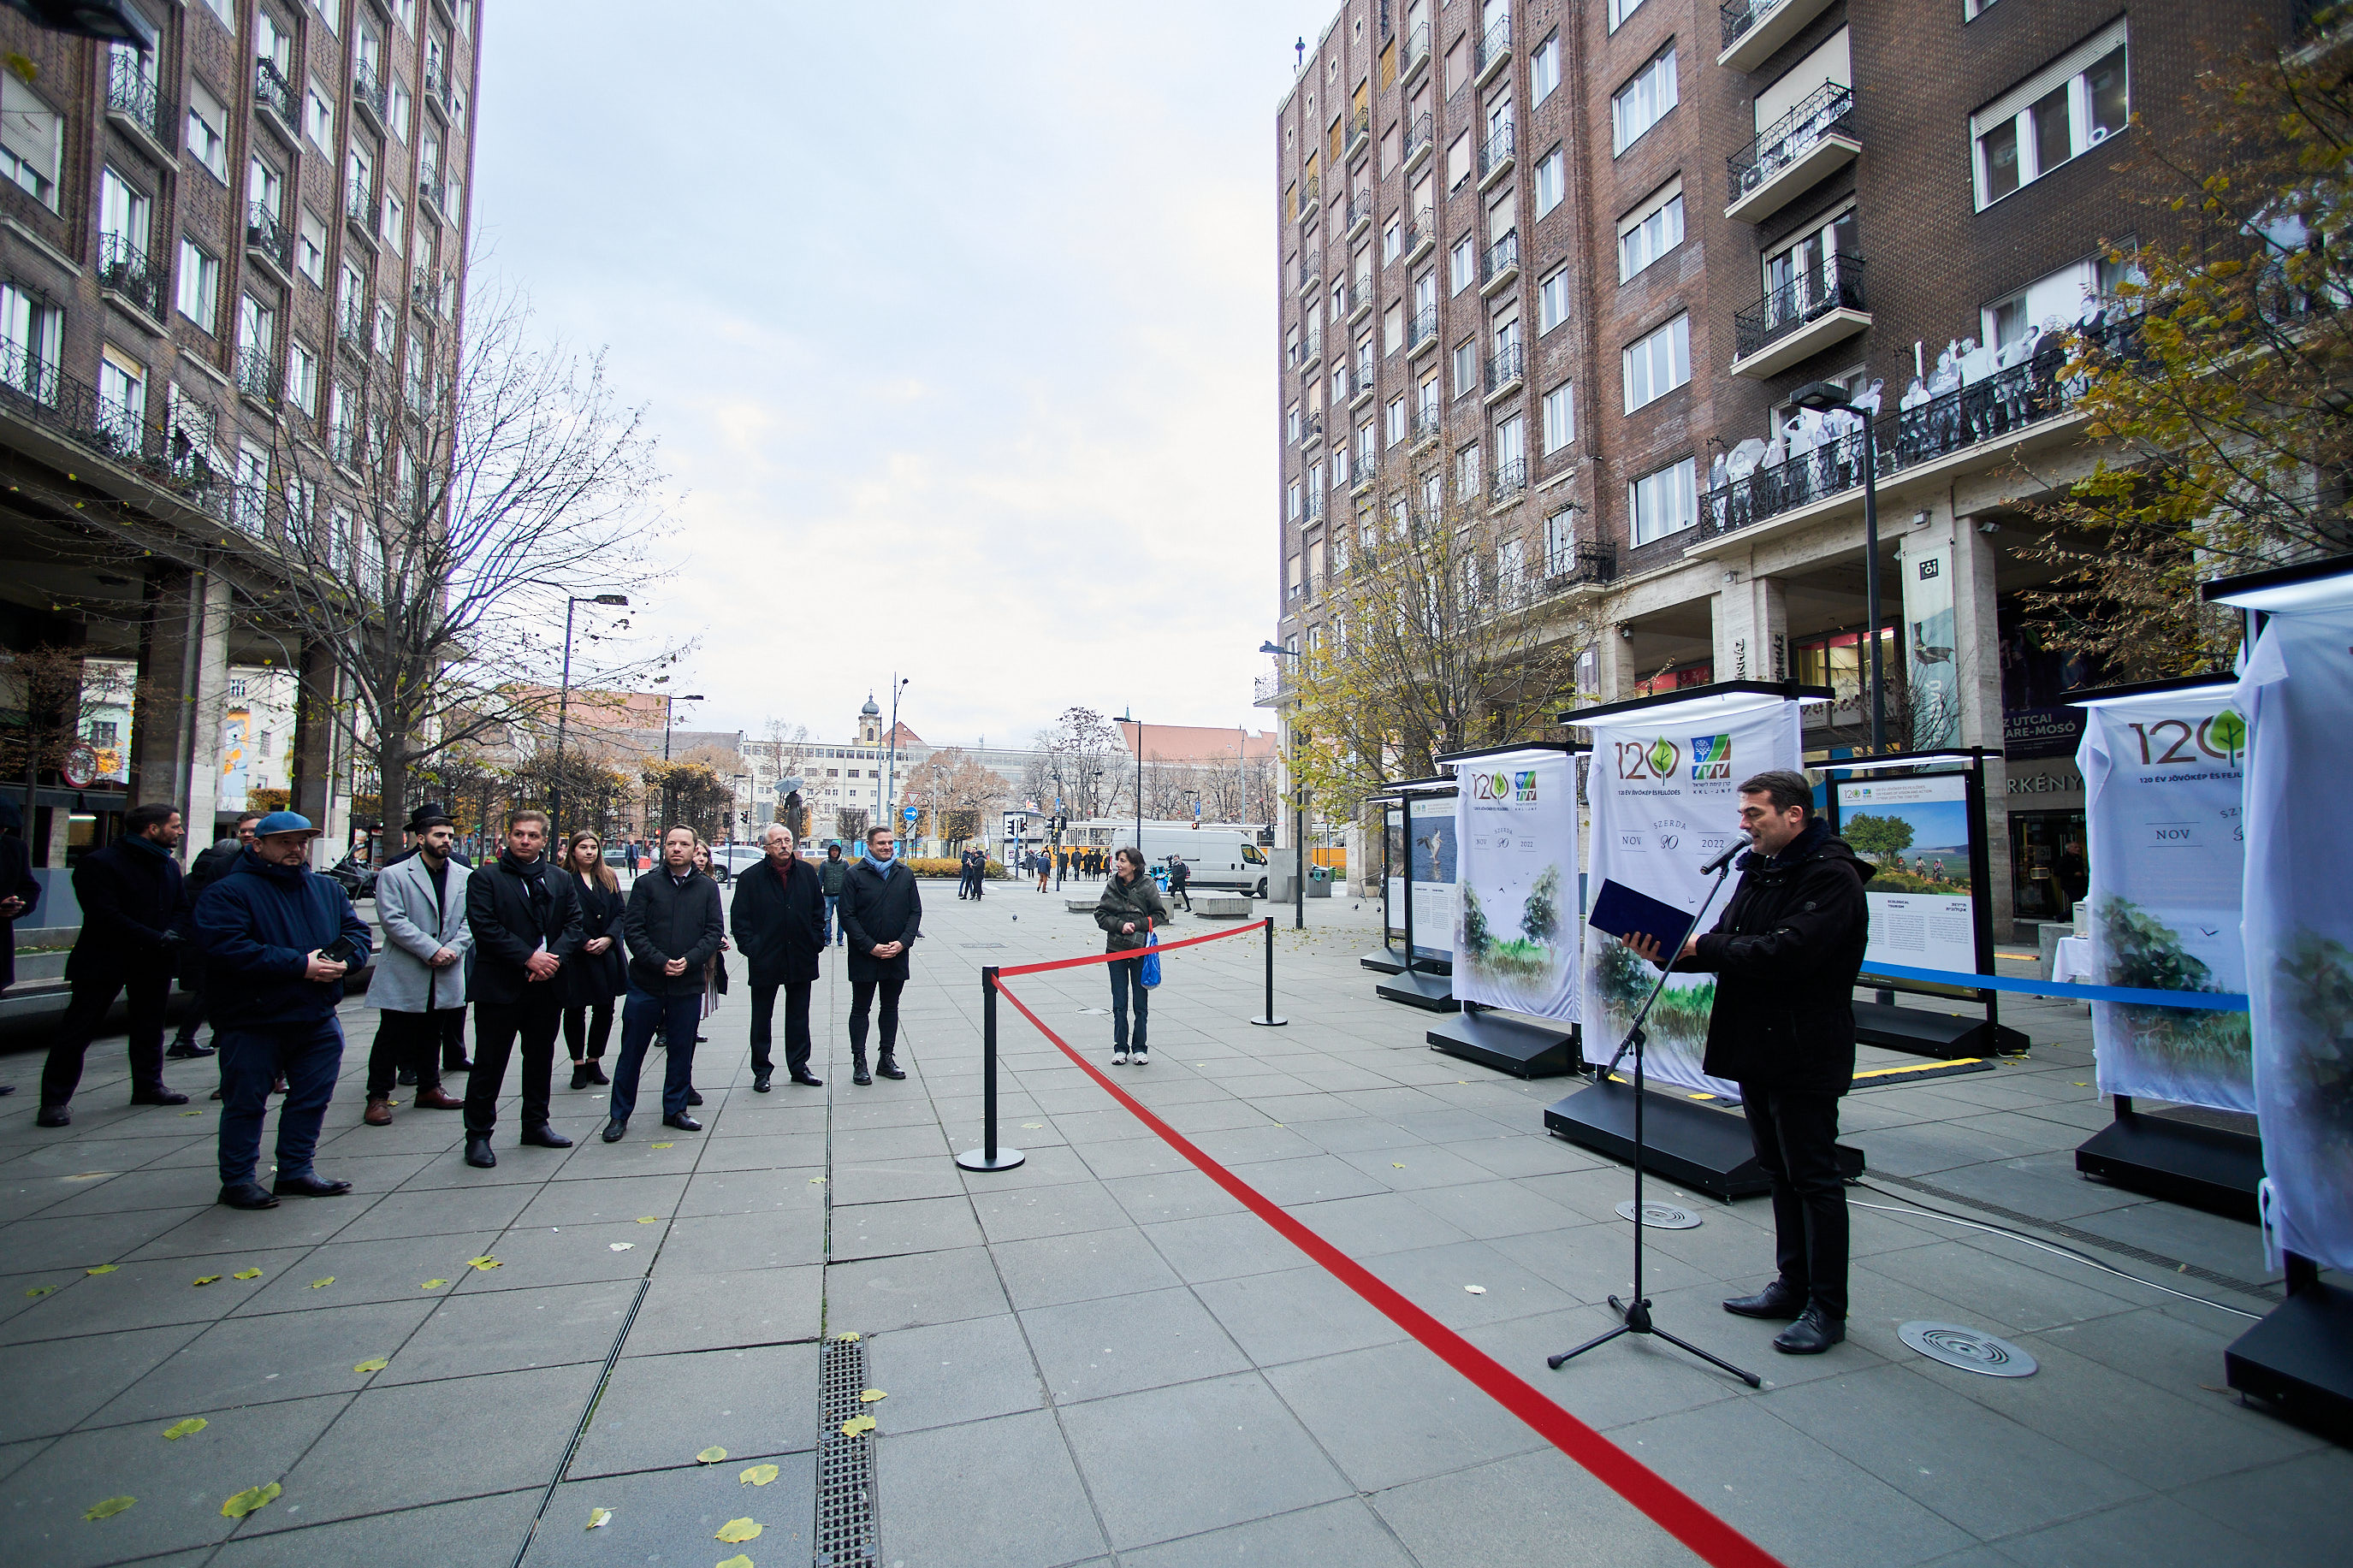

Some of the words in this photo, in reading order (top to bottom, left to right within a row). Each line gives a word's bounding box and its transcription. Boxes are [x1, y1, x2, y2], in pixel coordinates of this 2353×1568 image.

[2012, 713, 2052, 726] UTCAI
[2005, 720, 2077, 738] ARE-MOSÓ
[1615, 736, 1680, 785] 120
[2006, 772, 2086, 794] RKÉNY
[2167, 773, 2208, 782] JÖVŐKÉP
[1472, 771, 1509, 803] 120
[1653, 820, 1686, 830] SZERDA
[1622, 836, 1641, 845] NOV
[1660, 834, 1679, 849] 30
[1701, 839, 1724, 848] 2022
[2155, 829, 2190, 840] NOV
[1497, 837, 1509, 848] 30
